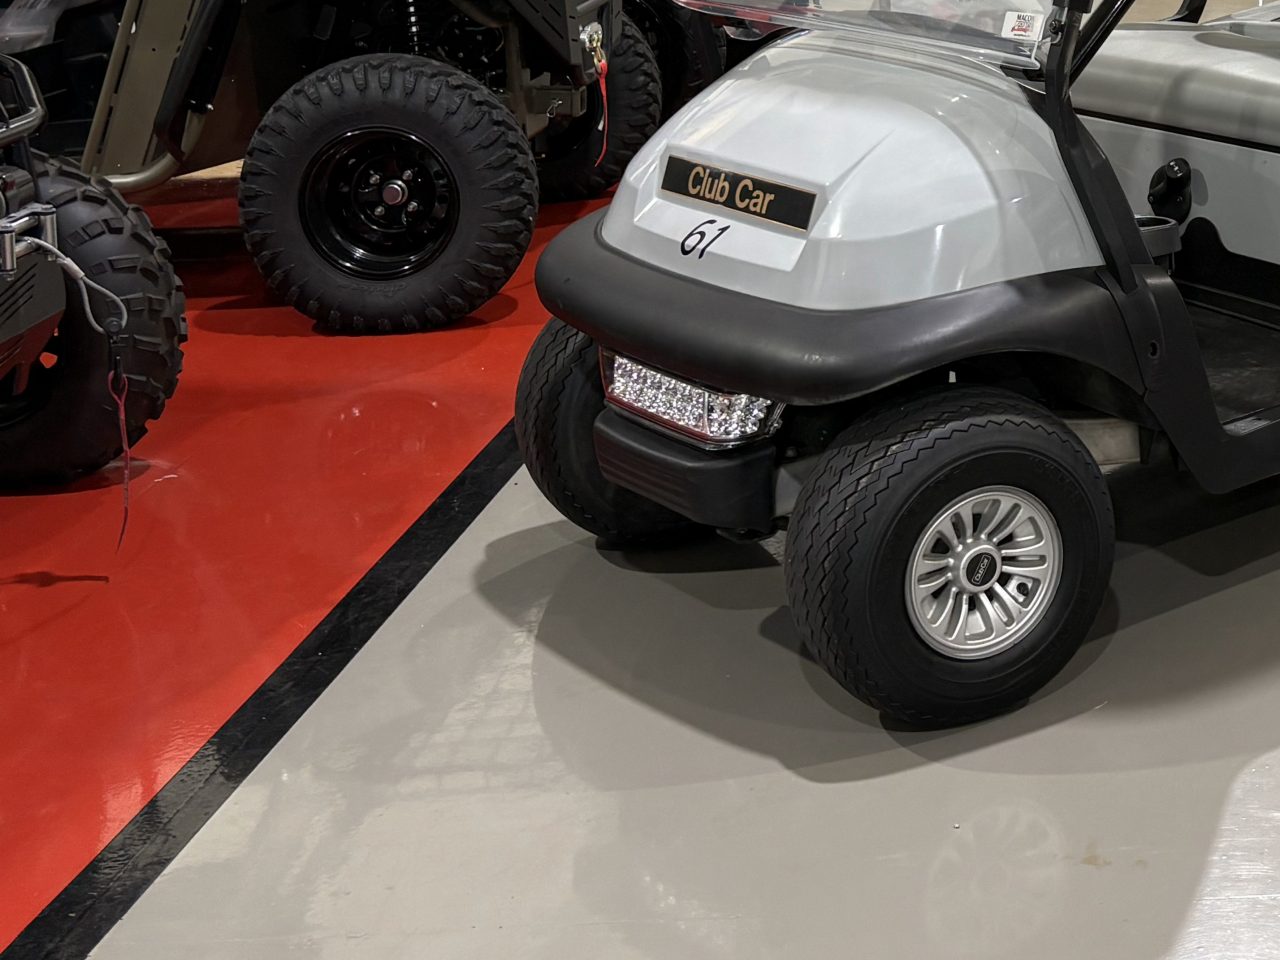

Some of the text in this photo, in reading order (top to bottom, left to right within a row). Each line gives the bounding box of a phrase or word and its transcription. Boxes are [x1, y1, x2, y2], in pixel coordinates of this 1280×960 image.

[687, 166, 775, 215] Club Car
[680, 219, 731, 260] 61
